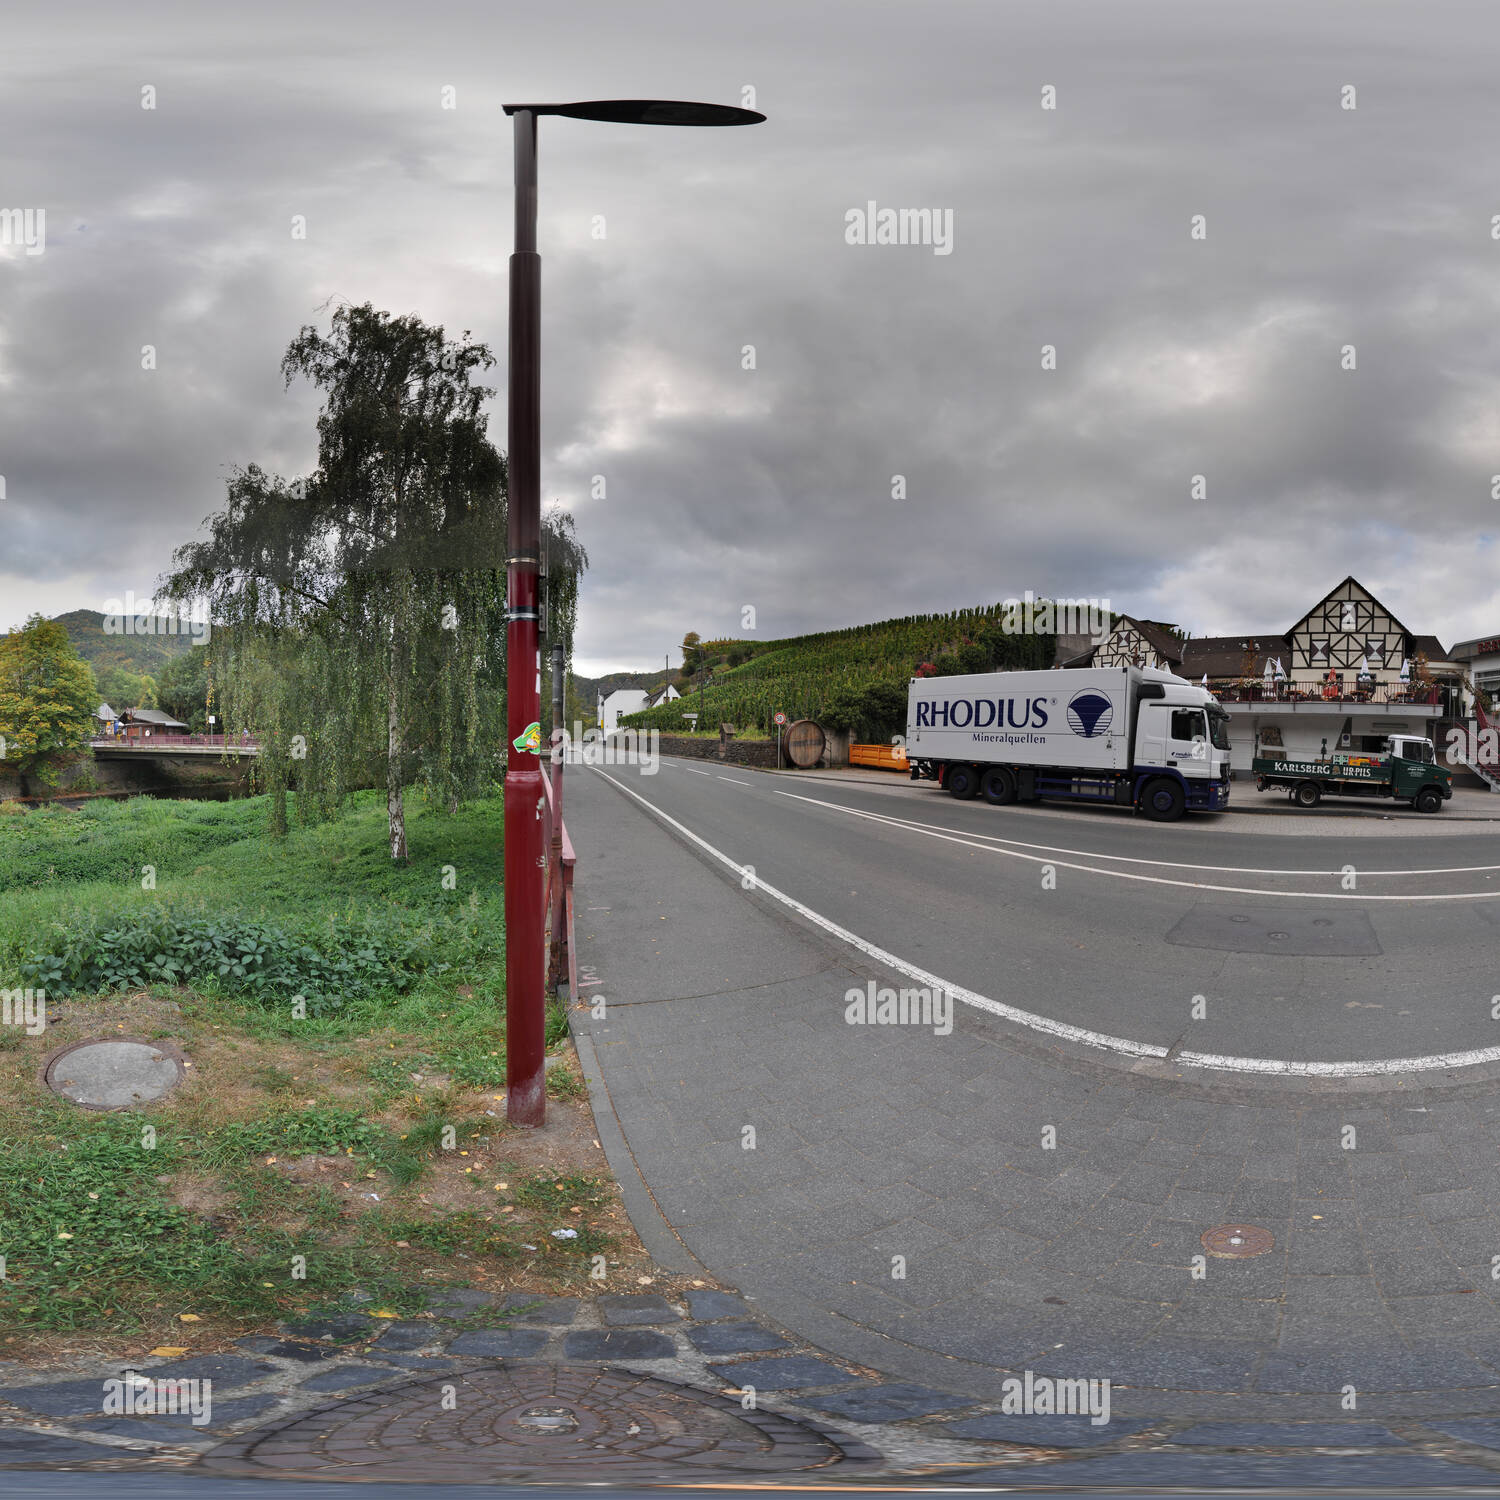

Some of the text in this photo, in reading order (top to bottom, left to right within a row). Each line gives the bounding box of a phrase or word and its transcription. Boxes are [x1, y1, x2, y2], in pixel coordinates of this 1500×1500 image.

[916, 697, 1049, 728] RHODIUS
[972, 732, 1046, 745] Mineralquellen
[1274, 761, 1331, 774] KARLSBERG
